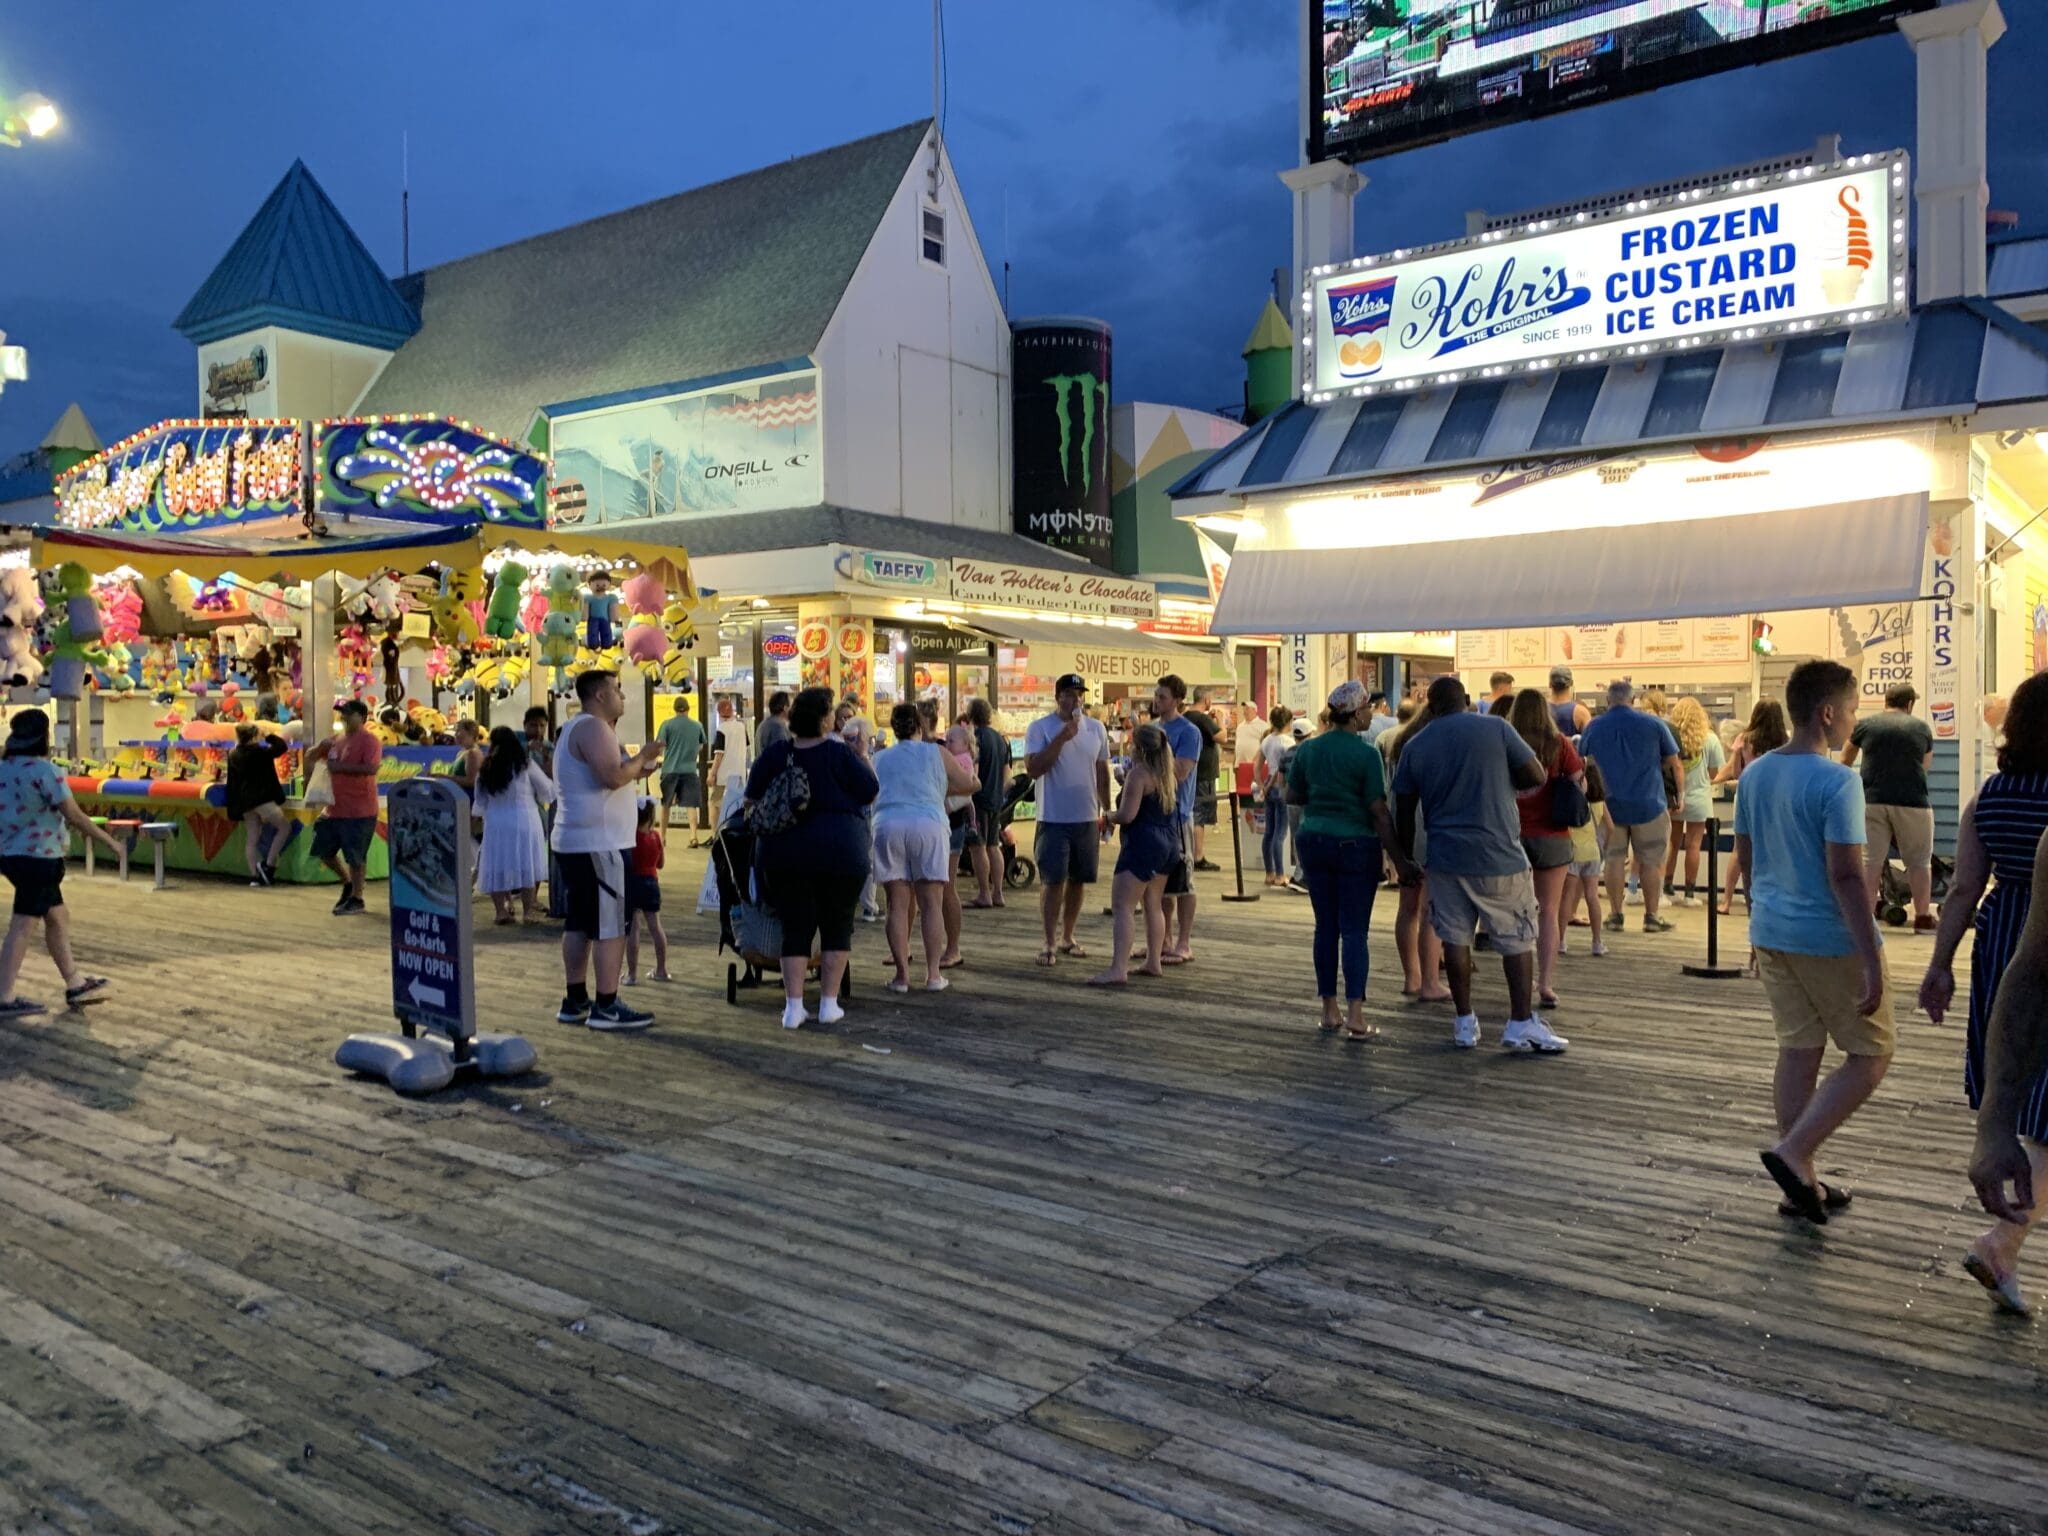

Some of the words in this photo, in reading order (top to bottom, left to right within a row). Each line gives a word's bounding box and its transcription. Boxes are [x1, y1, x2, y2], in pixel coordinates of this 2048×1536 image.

[1621, 202, 1779, 261] FROZEN
[1605, 243, 1796, 303] CUSTARD
[1400, 257, 1567, 349] Kohr's
[1606, 306, 1655, 336] ICE
[1672, 283, 1795, 325] CREAM
[1463, 330, 1489, 345] THE
[1492, 308, 1553, 334] ORIGINAL
[1522, 329, 1560, 344] SINCE
[1566, 324, 1592, 337] 1919
[705, 460, 774, 479] O'NEILL
[1523, 469, 1543, 484] THE
[1548, 454, 1599, 476] ORIGINAL
[1597, 465, 1637, 477] Since
[1602, 473, 1630, 484] 1919
[873, 560, 924, 579] TAFFY
[956, 564, 997, 585] Van
[1000, 569, 1073, 594] Holten's
[1079, 578, 1153, 603] Chocolate
[1933, 559, 1955, 667] KOHRS
[765, 642, 796, 656] OPEN
[911, 635, 943, 650] Open
[946, 636, 961, 649] All
[1075, 653, 1128, 675] SWEET
[1132, 657, 1170, 677] SHOP
[409, 910, 429, 930] Golf
[431, 915, 440, 933] &
[404, 928, 446, 954] Go-Karts
[399, 950, 422, 972] NOW
[425, 957, 454, 981] OPEN
